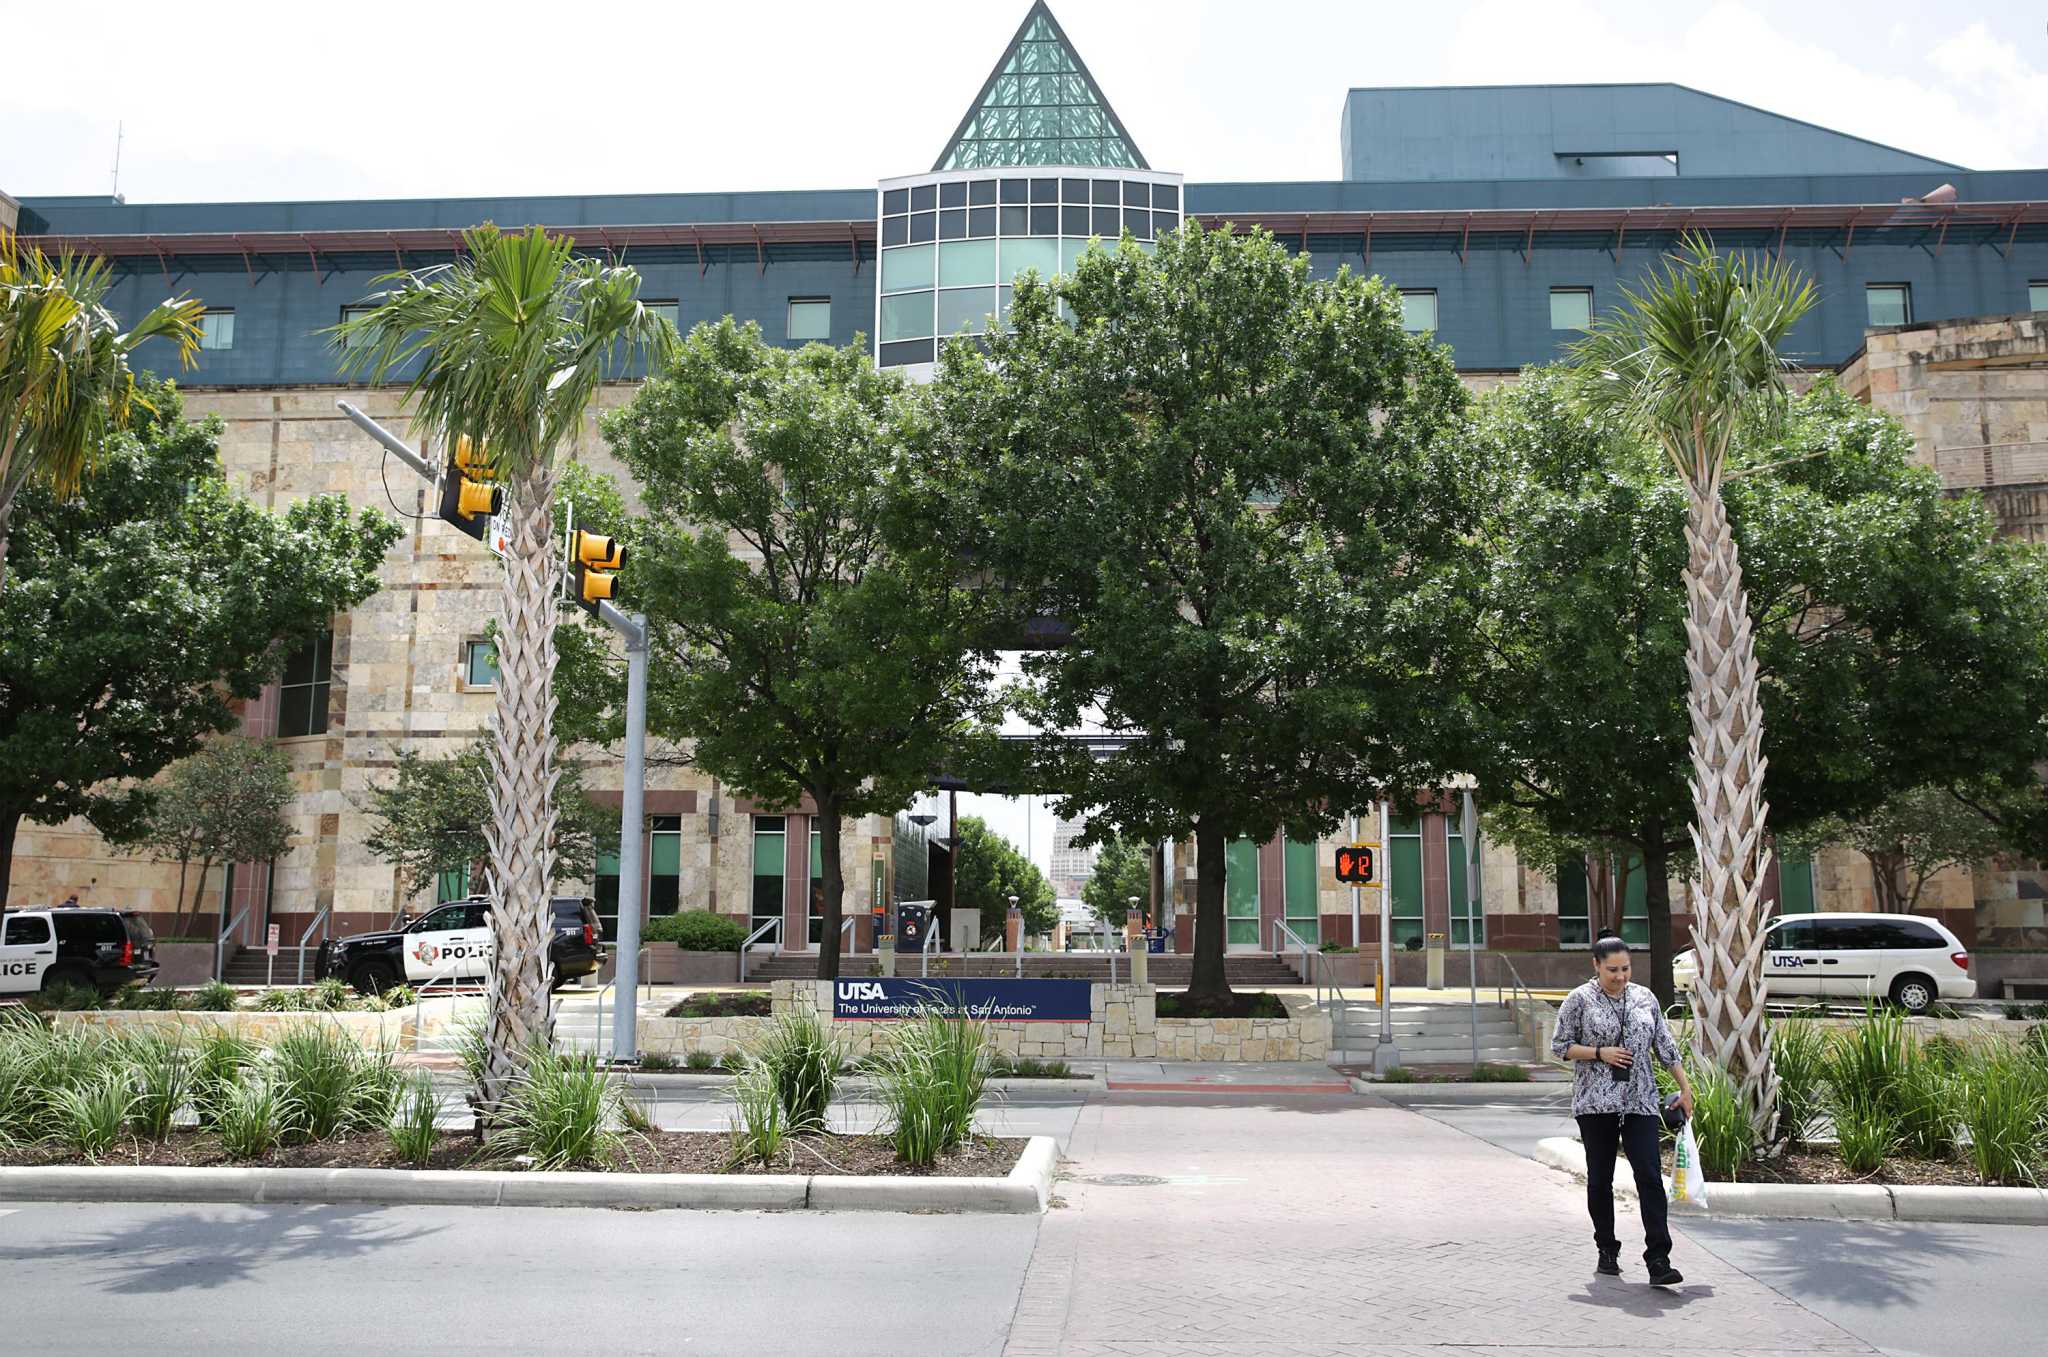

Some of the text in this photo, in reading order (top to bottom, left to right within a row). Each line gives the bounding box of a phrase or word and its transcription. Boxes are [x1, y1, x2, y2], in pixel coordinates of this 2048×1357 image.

[442, 944, 493, 960] POLIC
[1773, 956, 1803, 967] UTSA
[0, 962, 37, 976] ICE
[838, 1003, 858, 1014] The
[861, 1003, 910, 1016] University
[970, 1004, 991, 1015] San
